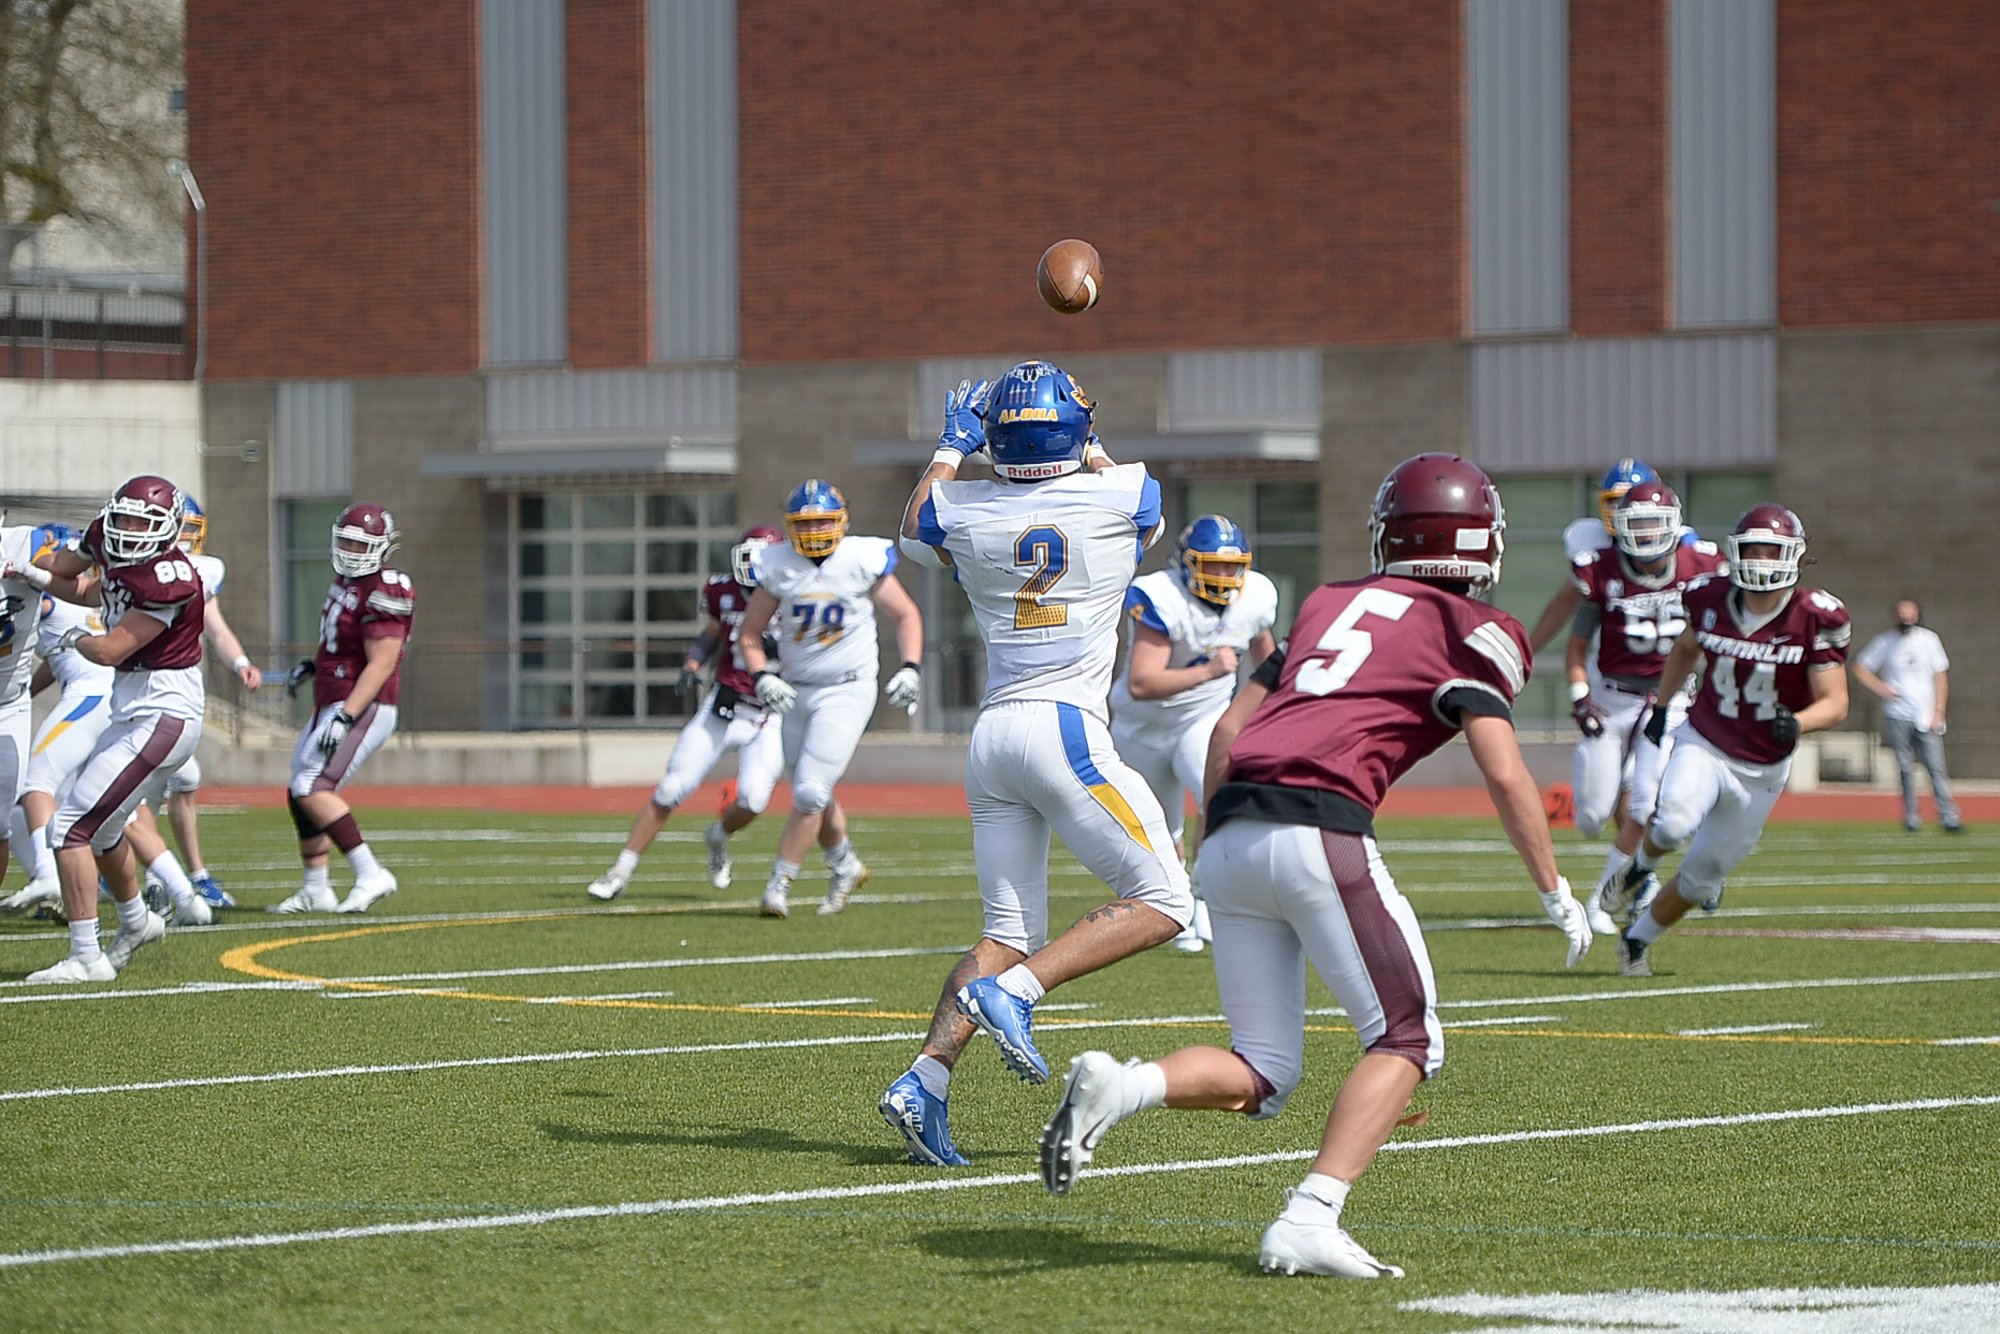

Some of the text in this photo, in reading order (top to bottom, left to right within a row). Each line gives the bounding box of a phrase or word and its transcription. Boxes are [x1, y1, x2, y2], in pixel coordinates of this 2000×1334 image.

[998, 408, 1059, 423] ALOHA
[1007, 465, 1062, 477] Riddell
[1013, 524, 1068, 631] 2
[1412, 564, 1469, 576] Riddell
[1295, 587, 1415, 697] 5
[1712, 655, 1779, 722] 44
